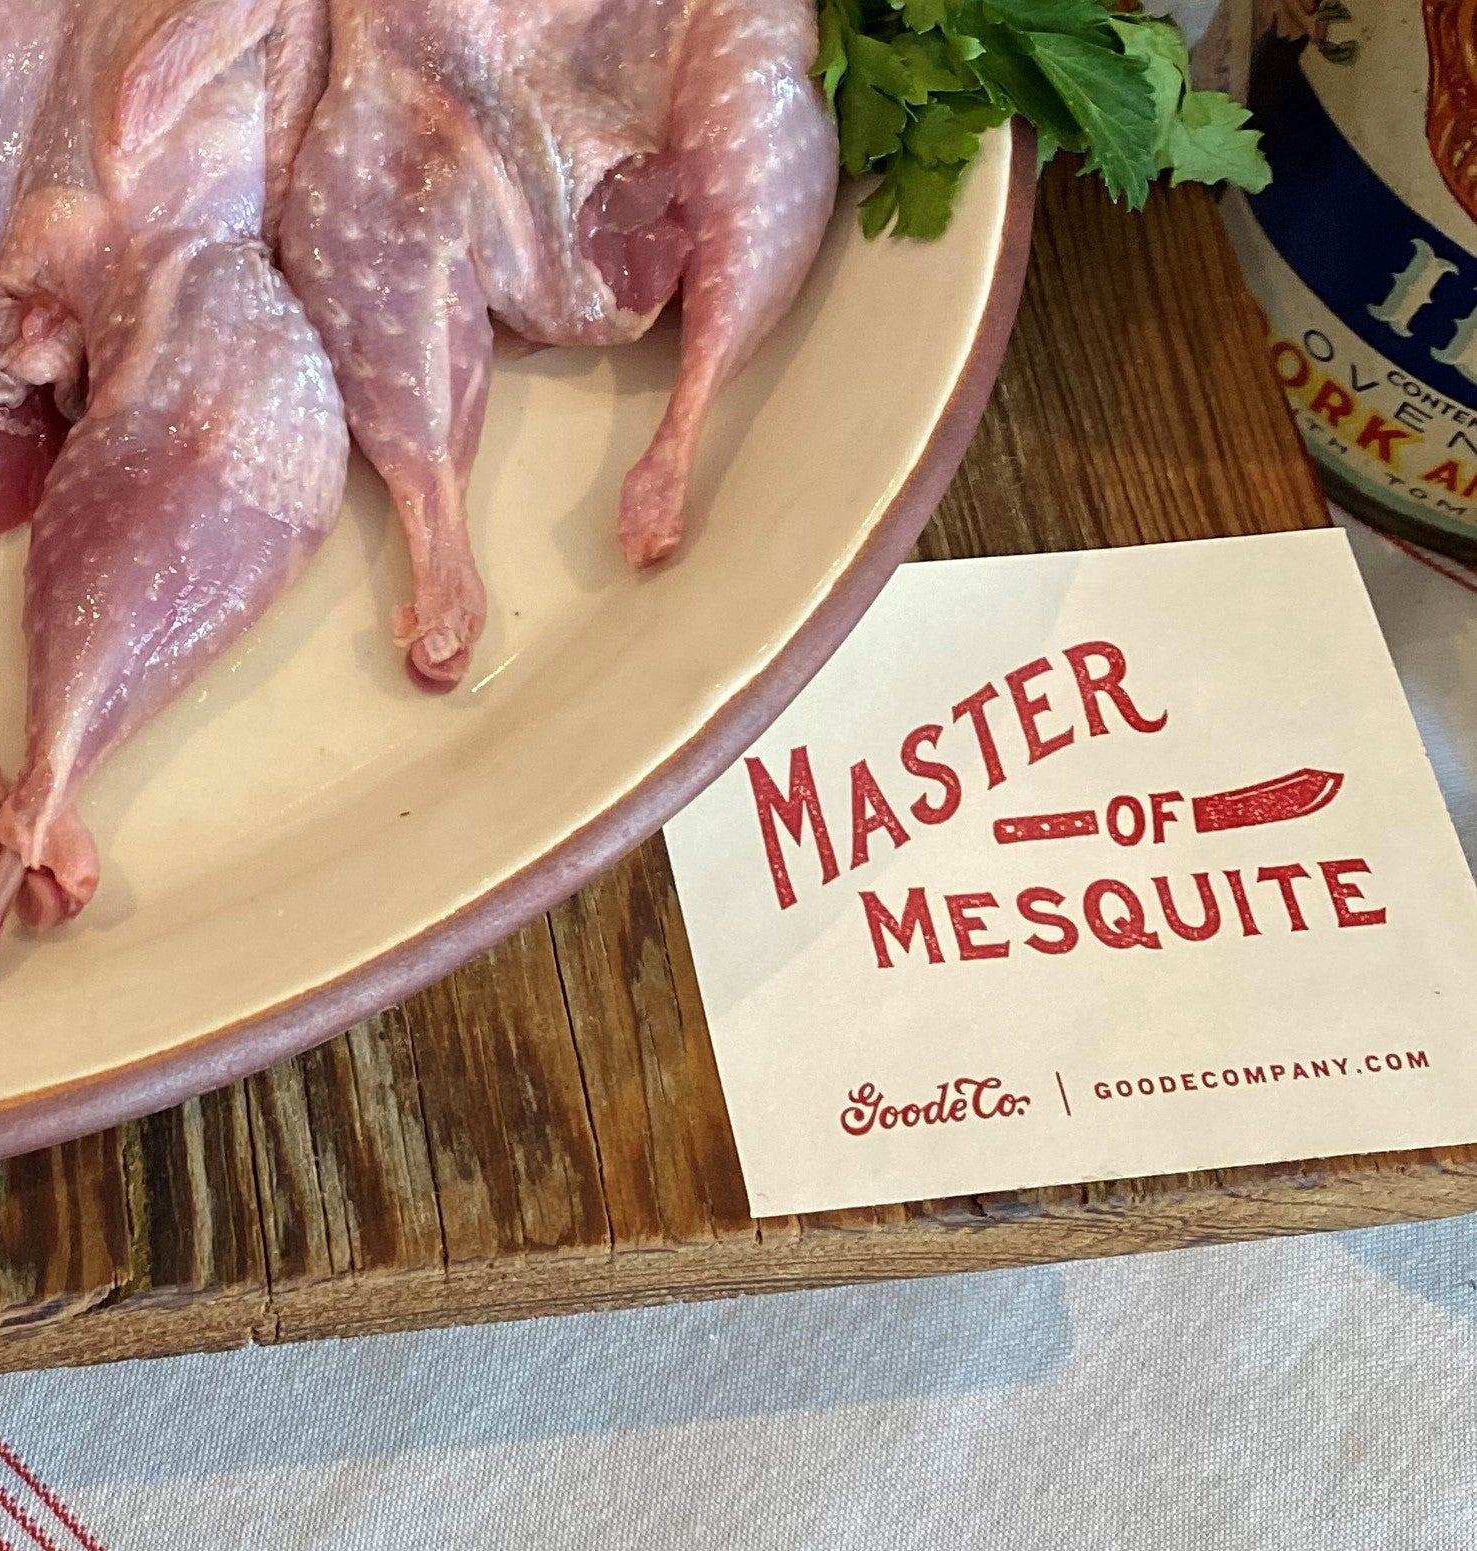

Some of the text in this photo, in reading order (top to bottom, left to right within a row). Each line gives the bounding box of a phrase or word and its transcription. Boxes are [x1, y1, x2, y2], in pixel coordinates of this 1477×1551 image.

[743, 640, 1169, 911] MASTER
[1106, 790, 1185, 847] OF
[857, 858, 1387, 969] MESQUITE
[1093, 1050, 1430, 1102] GOODECOMPANY.COM
